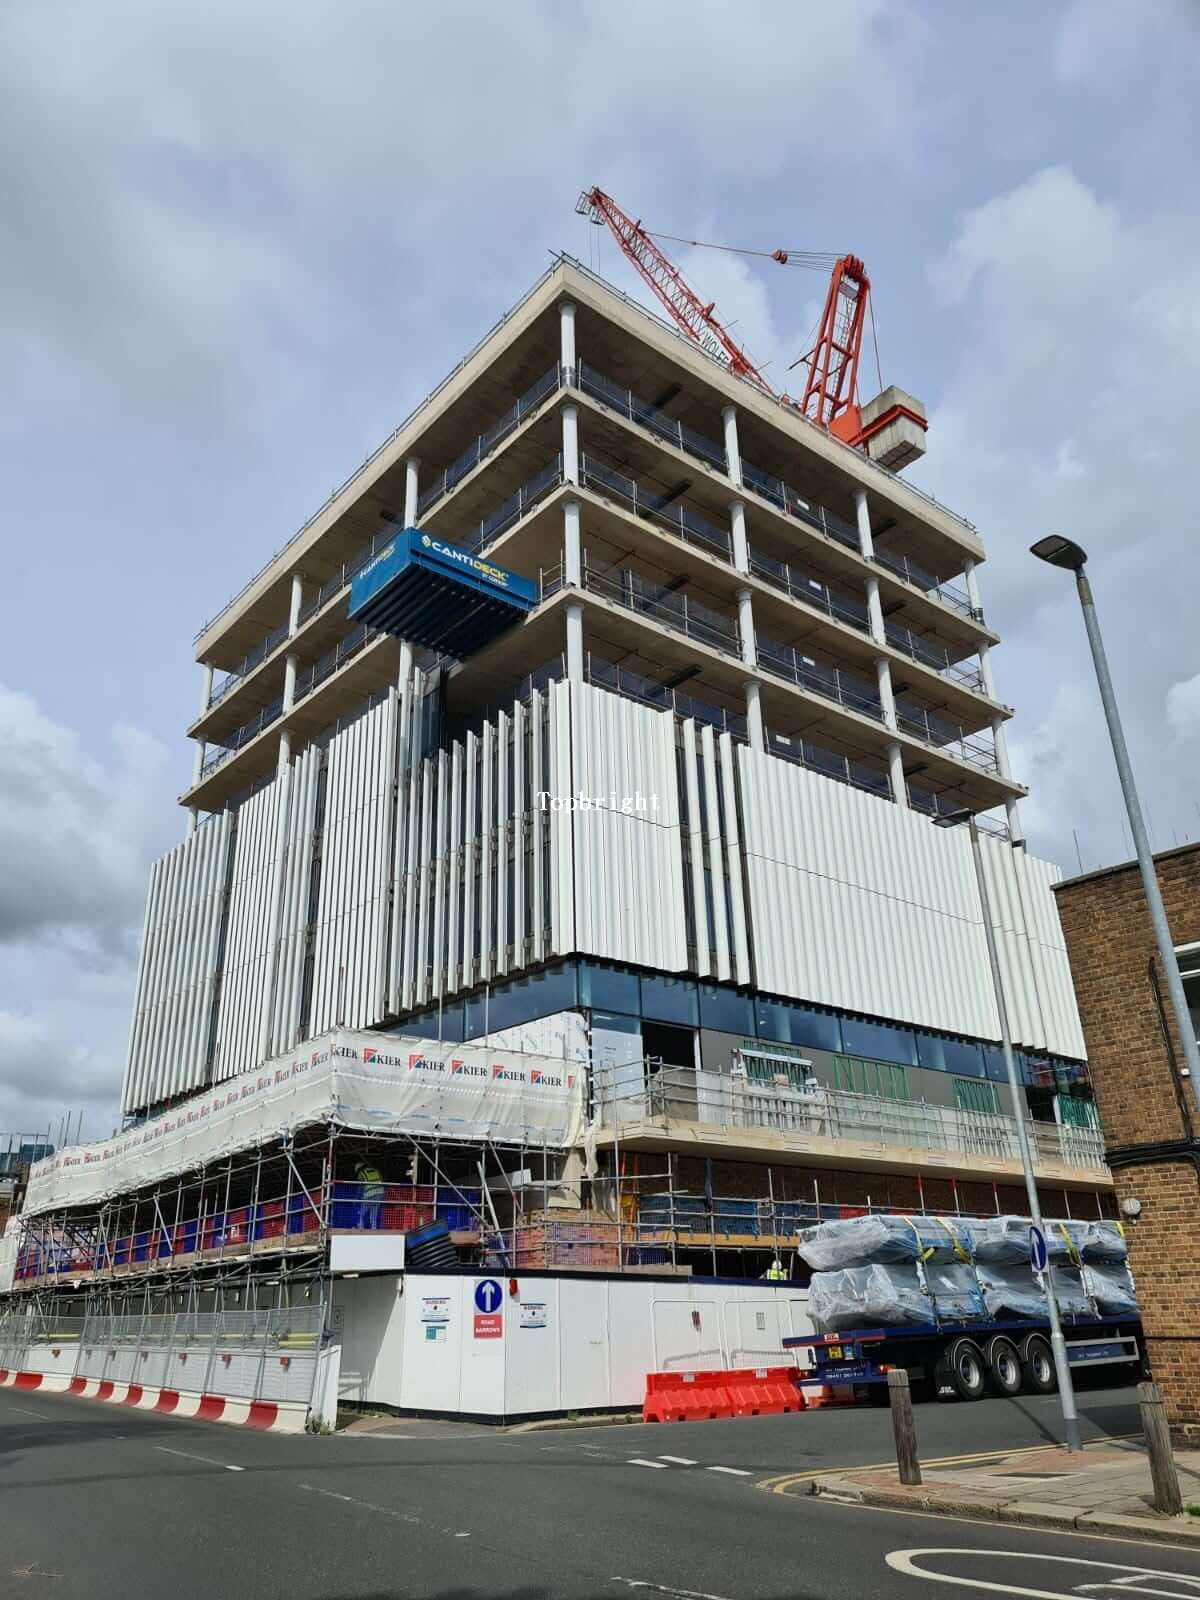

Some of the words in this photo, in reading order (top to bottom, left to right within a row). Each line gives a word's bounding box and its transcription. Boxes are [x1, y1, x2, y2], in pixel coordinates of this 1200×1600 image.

[431, 541, 509, 583] CANTIDECK
[335, 1046, 358, 1060] KIER
[376, 1054, 401, 1067] KIER
[422, 1059, 446, 1073] KIER
[463, 1065, 487, 1077] KIER
[503, 1071, 526, 1082] KIER
[541, 1075, 562, 1087] KIER
